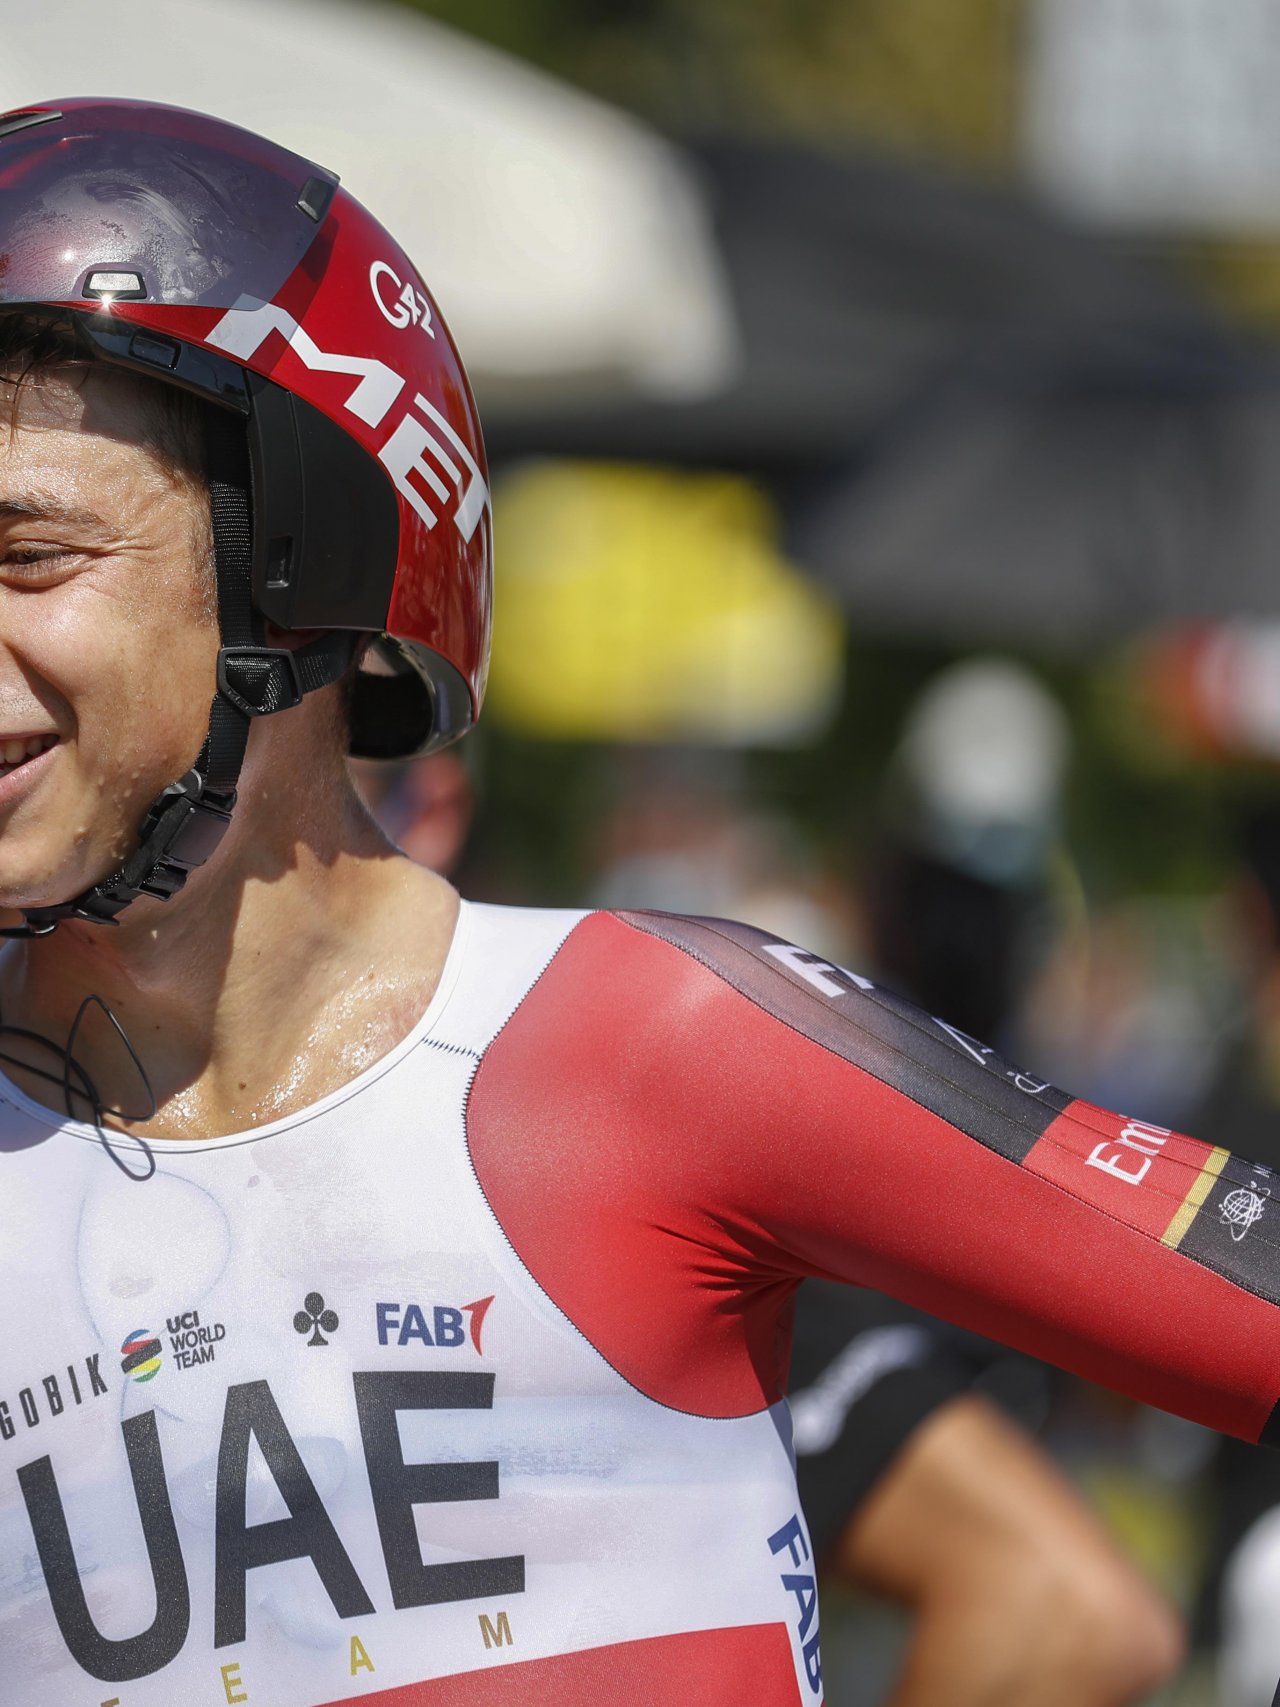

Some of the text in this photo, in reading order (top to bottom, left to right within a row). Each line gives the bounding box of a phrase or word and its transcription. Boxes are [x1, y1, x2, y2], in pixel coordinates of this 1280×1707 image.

[204, 293, 491, 544] MET
[166, 1310, 200, 1335] UCI
[170, 1323, 226, 1353] WORLD
[376, 1302, 465, 1348] FAB
[173, 1344, 215, 1371] TEAM
[16, 1370, 526, 1683] UAE
[100, 1611, 514, 1707] EAM
